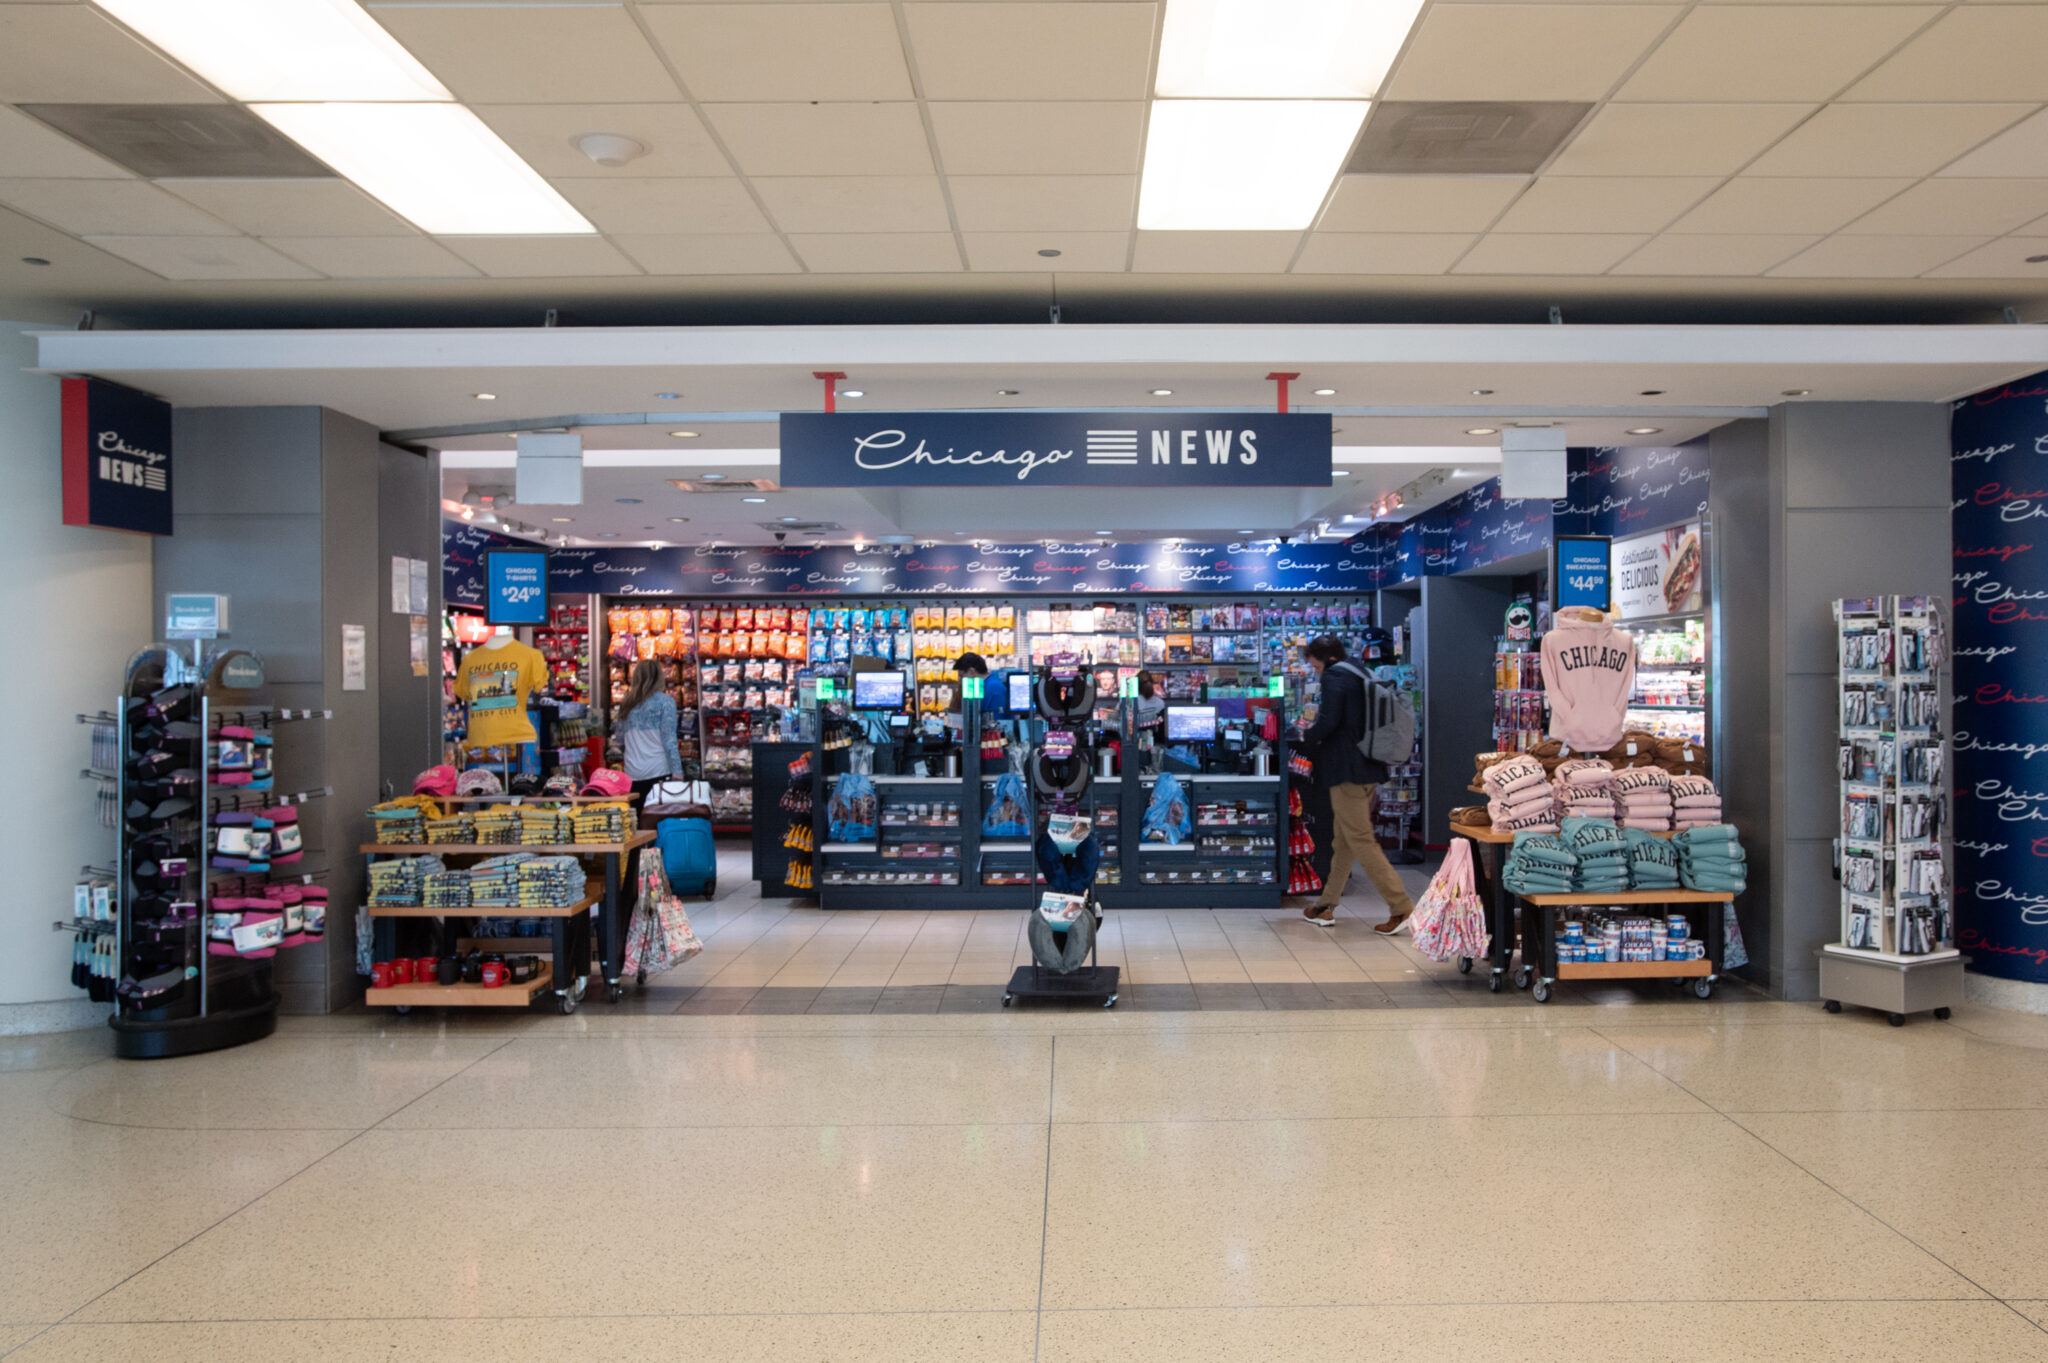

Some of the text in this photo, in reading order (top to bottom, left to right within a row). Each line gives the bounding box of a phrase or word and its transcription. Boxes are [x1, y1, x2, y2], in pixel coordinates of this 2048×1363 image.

[98, 430, 167, 465] Chicago
[854, 429, 1258, 480] Chicago NEWS
[1950, 443, 2015, 463] icago
[99, 455, 144, 487] NEWS
[1974, 482, 2048, 505] Chic
[1621, 564, 1659, 591] DELICIOUS
[1974, 582, 2048, 604] Chic
[1560, 645, 1628, 672] CHICAGO
[1952, 646, 2017, 663] icago
[1975, 683, 2048, 704] Chic
[1493, 764, 1543, 788] HICAG
[1616, 773, 1672, 792] HICAG
[1976, 779, 2048, 800] Chic
[1976, 880, 2048, 902] Chic
